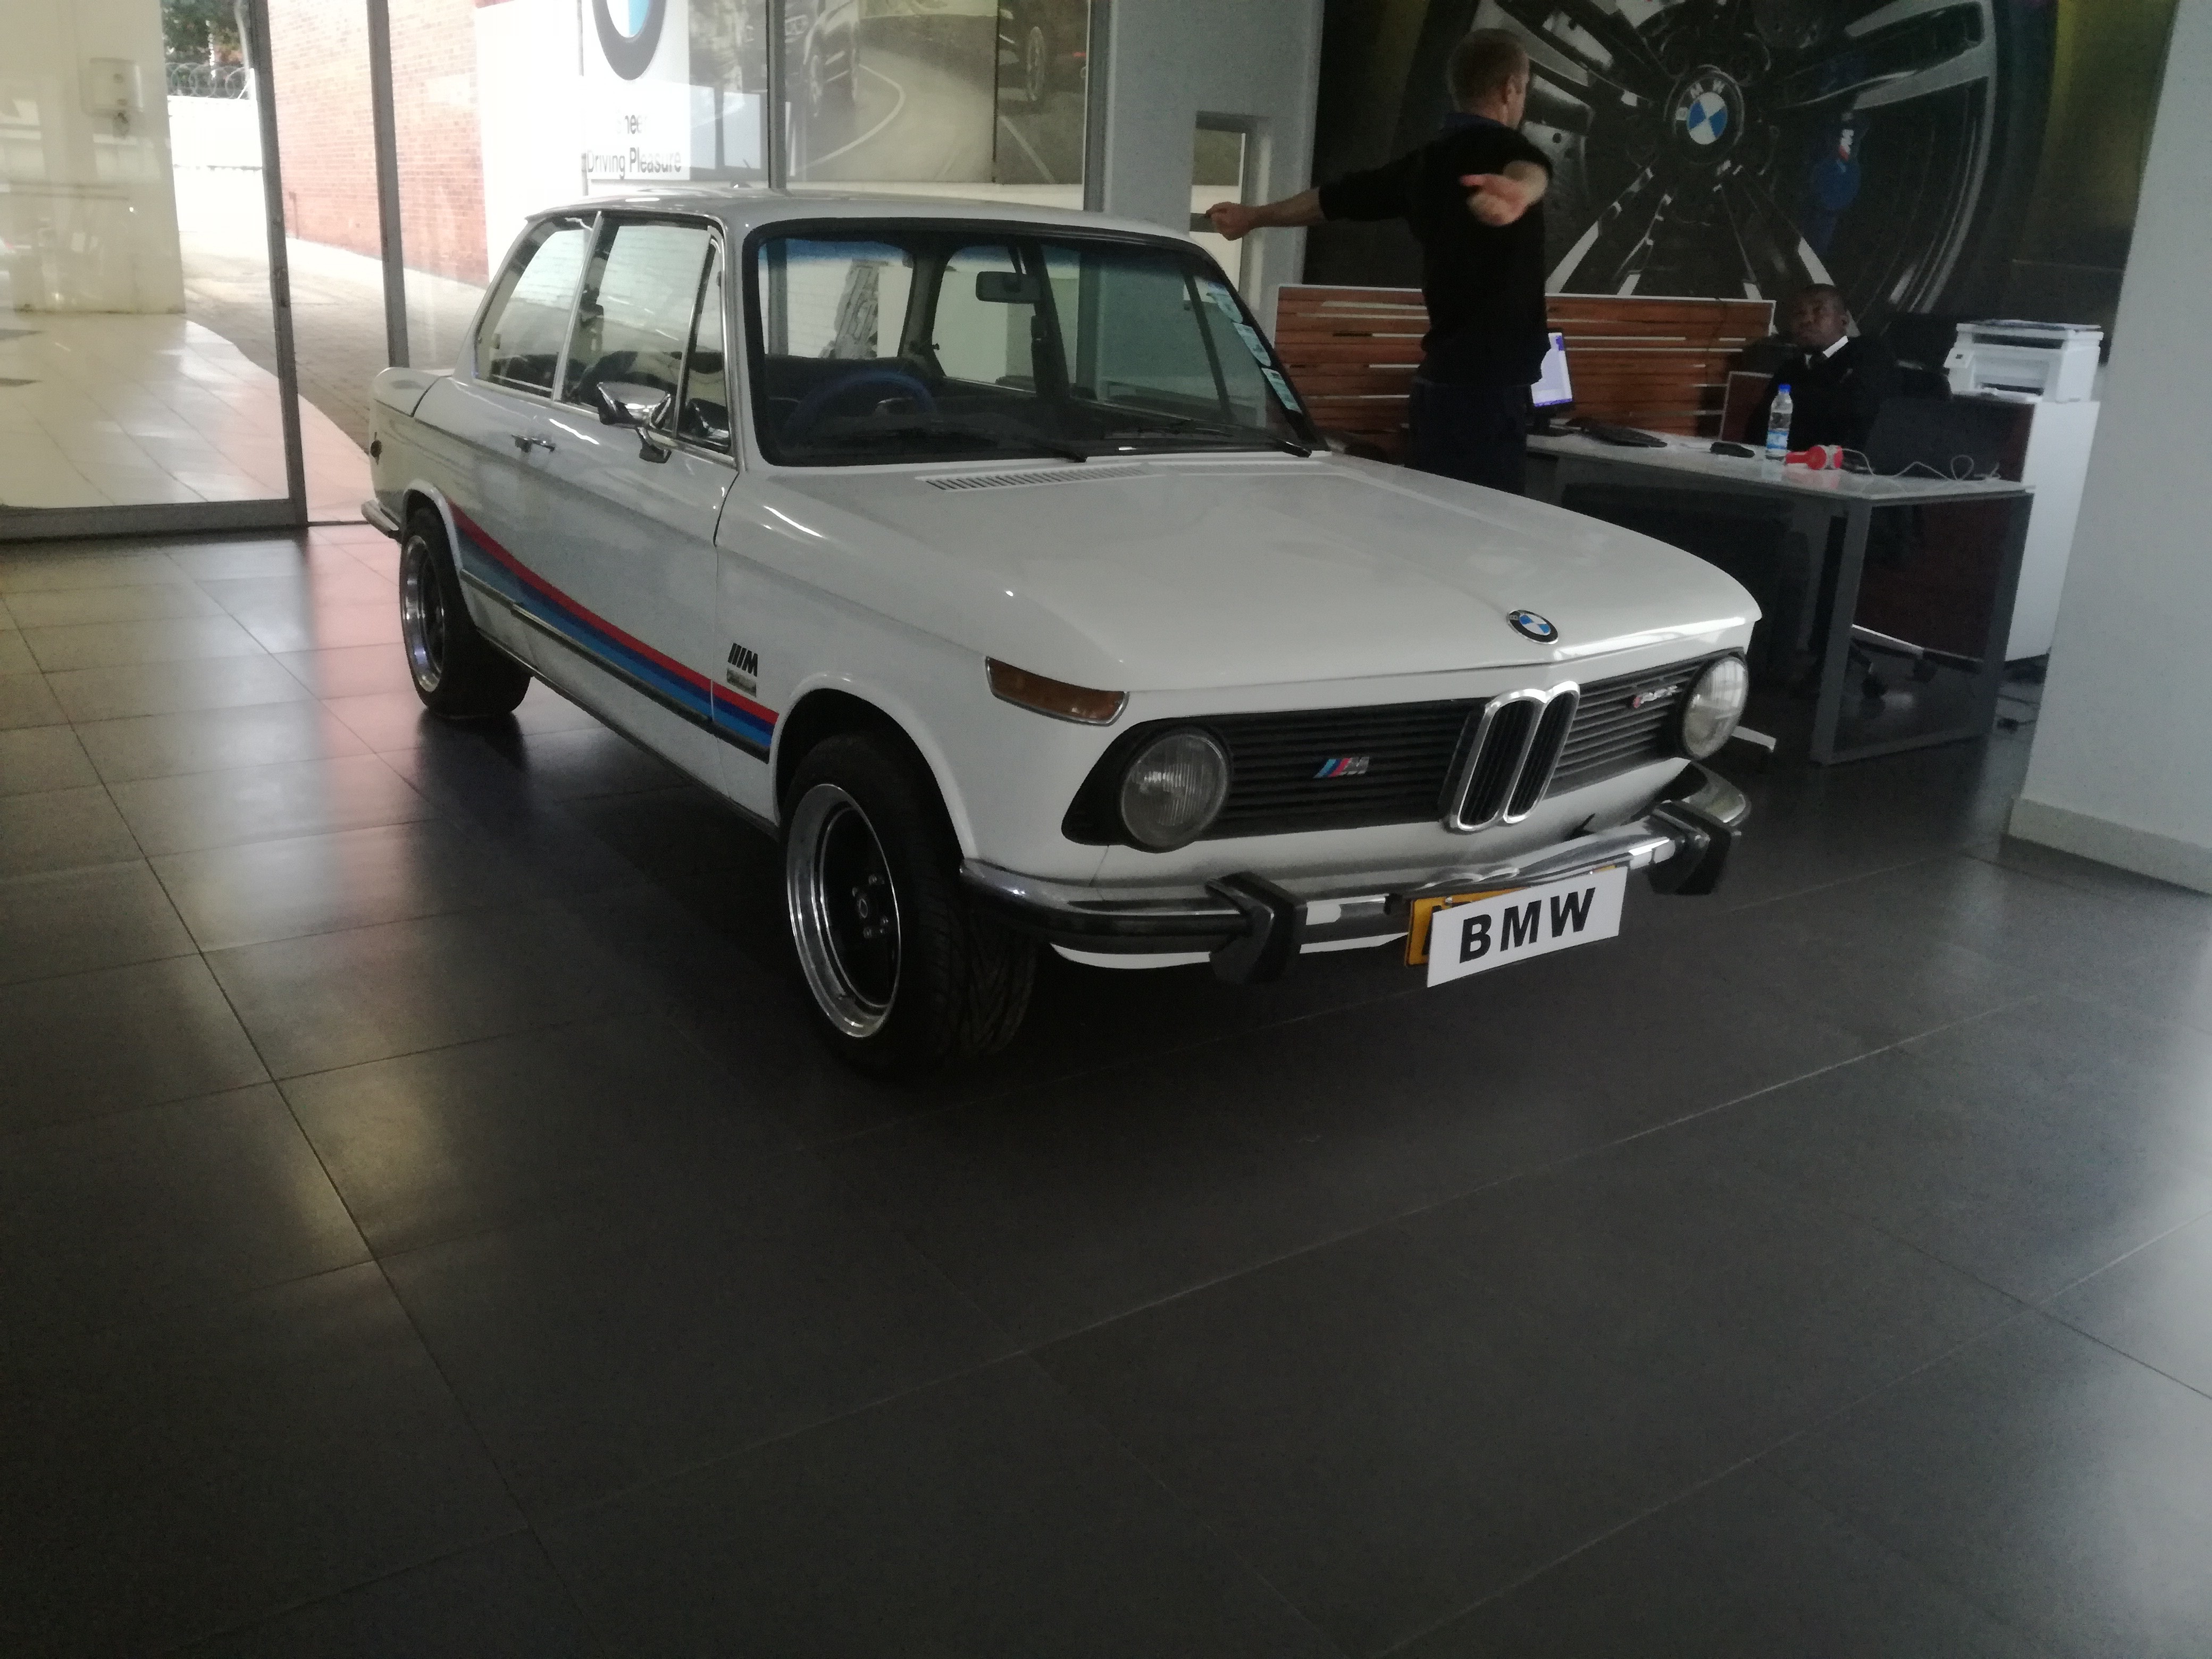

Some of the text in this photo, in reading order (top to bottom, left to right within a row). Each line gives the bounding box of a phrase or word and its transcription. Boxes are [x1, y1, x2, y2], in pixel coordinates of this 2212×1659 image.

[1675, 79, 1725, 121] BMW
[587, 147, 682, 179] Driving Pleasure
[1459, 887, 1596, 964] BMW
